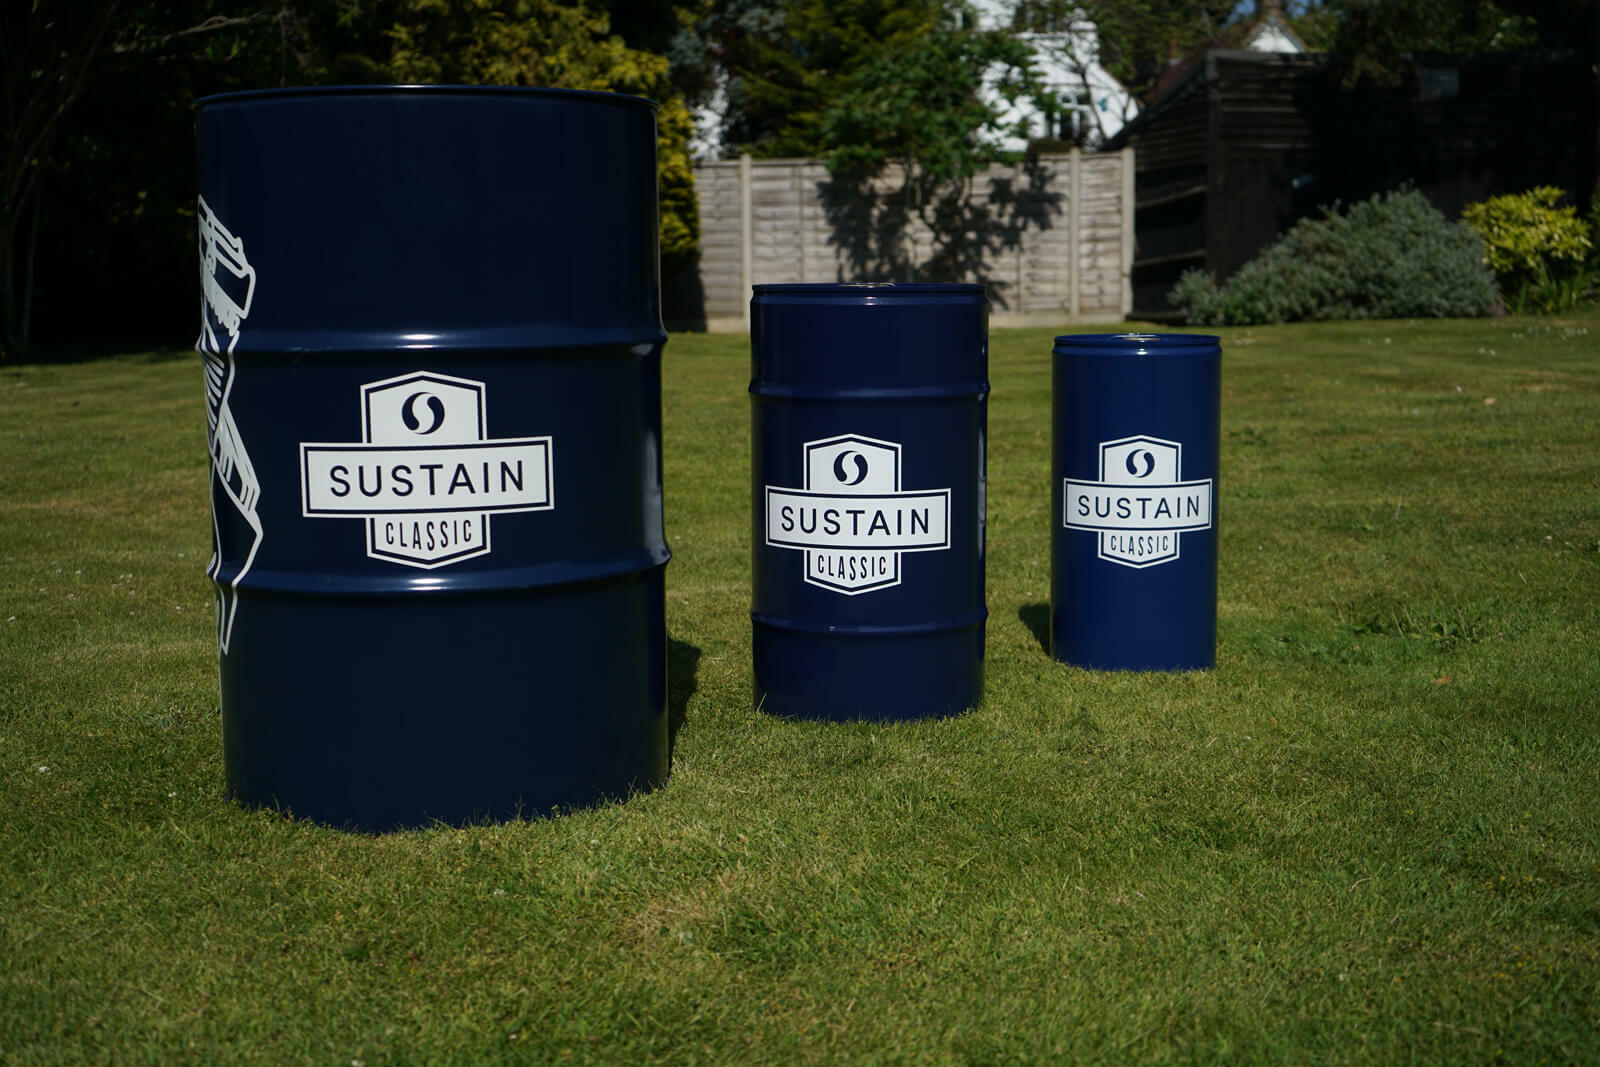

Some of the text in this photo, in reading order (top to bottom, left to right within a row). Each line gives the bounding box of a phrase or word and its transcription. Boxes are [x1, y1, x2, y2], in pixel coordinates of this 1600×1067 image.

[329, 460, 524, 497] SUSTAIN
[781, 505, 929, 536] SUSTAIN
[1078, 494, 1200, 519] SUSTAIN
[385, 519, 472, 551] CLASSIC
[1110, 535, 1169, 556] CLASSIC
[817, 554, 887, 581] CLASSIC
